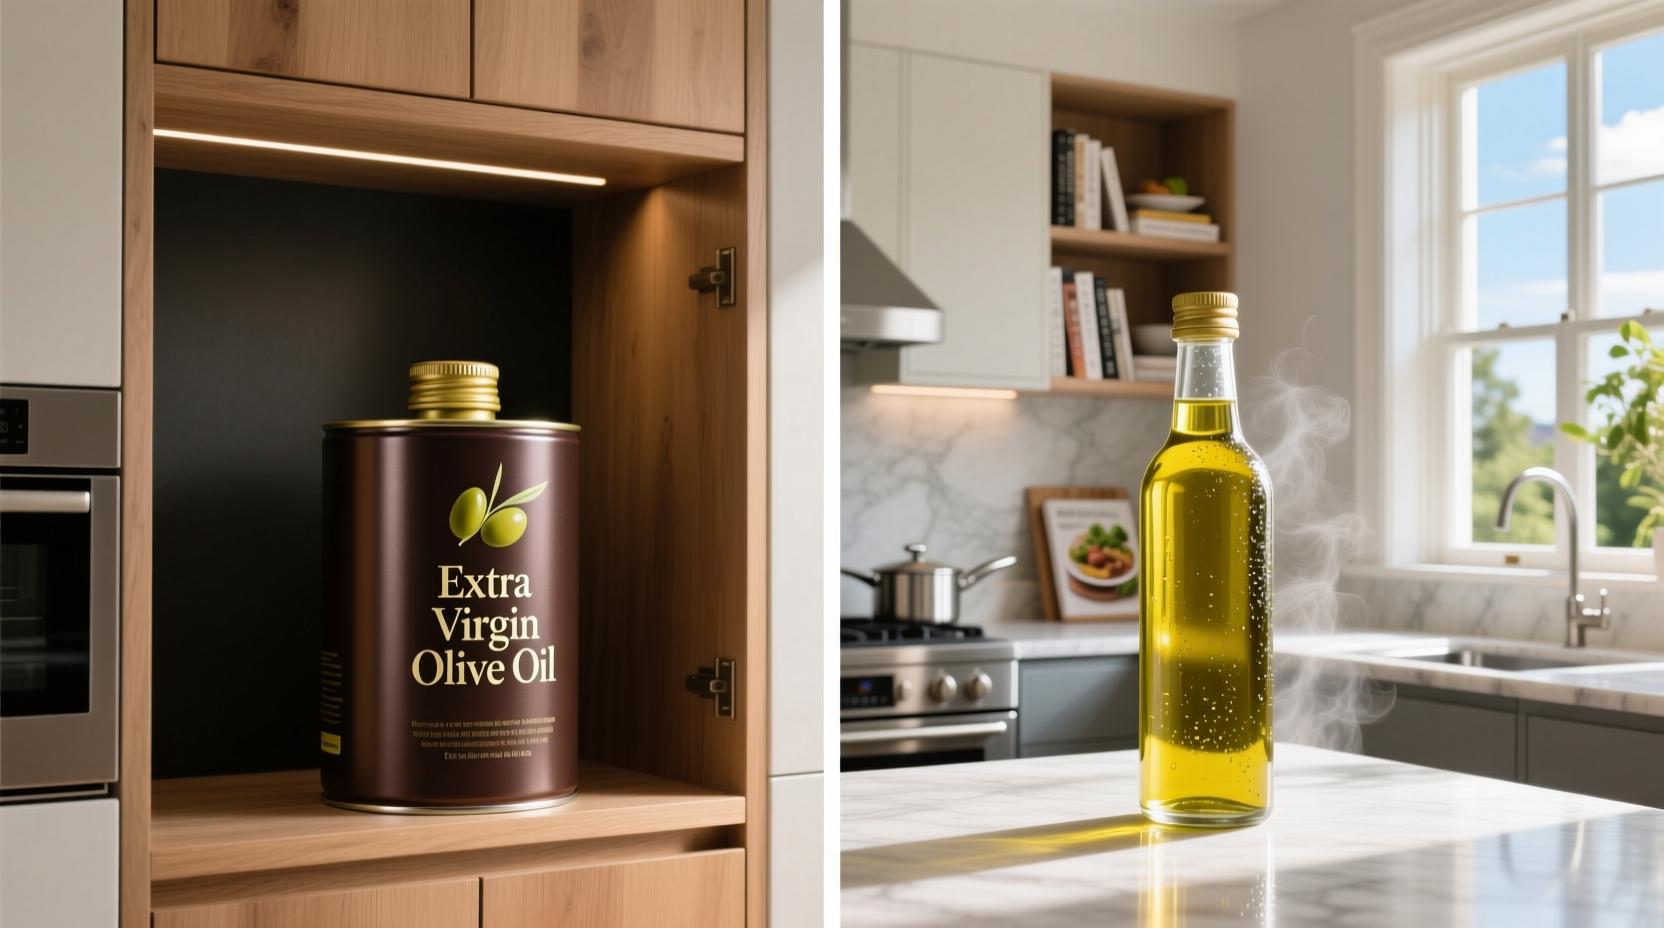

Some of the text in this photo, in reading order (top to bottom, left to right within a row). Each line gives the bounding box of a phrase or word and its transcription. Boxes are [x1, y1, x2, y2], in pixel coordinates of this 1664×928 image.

[437, 565, 533, 599] Extra
[431, 606, 540, 652] Virgin
[411, 645, 557, 687] Olive Oil
